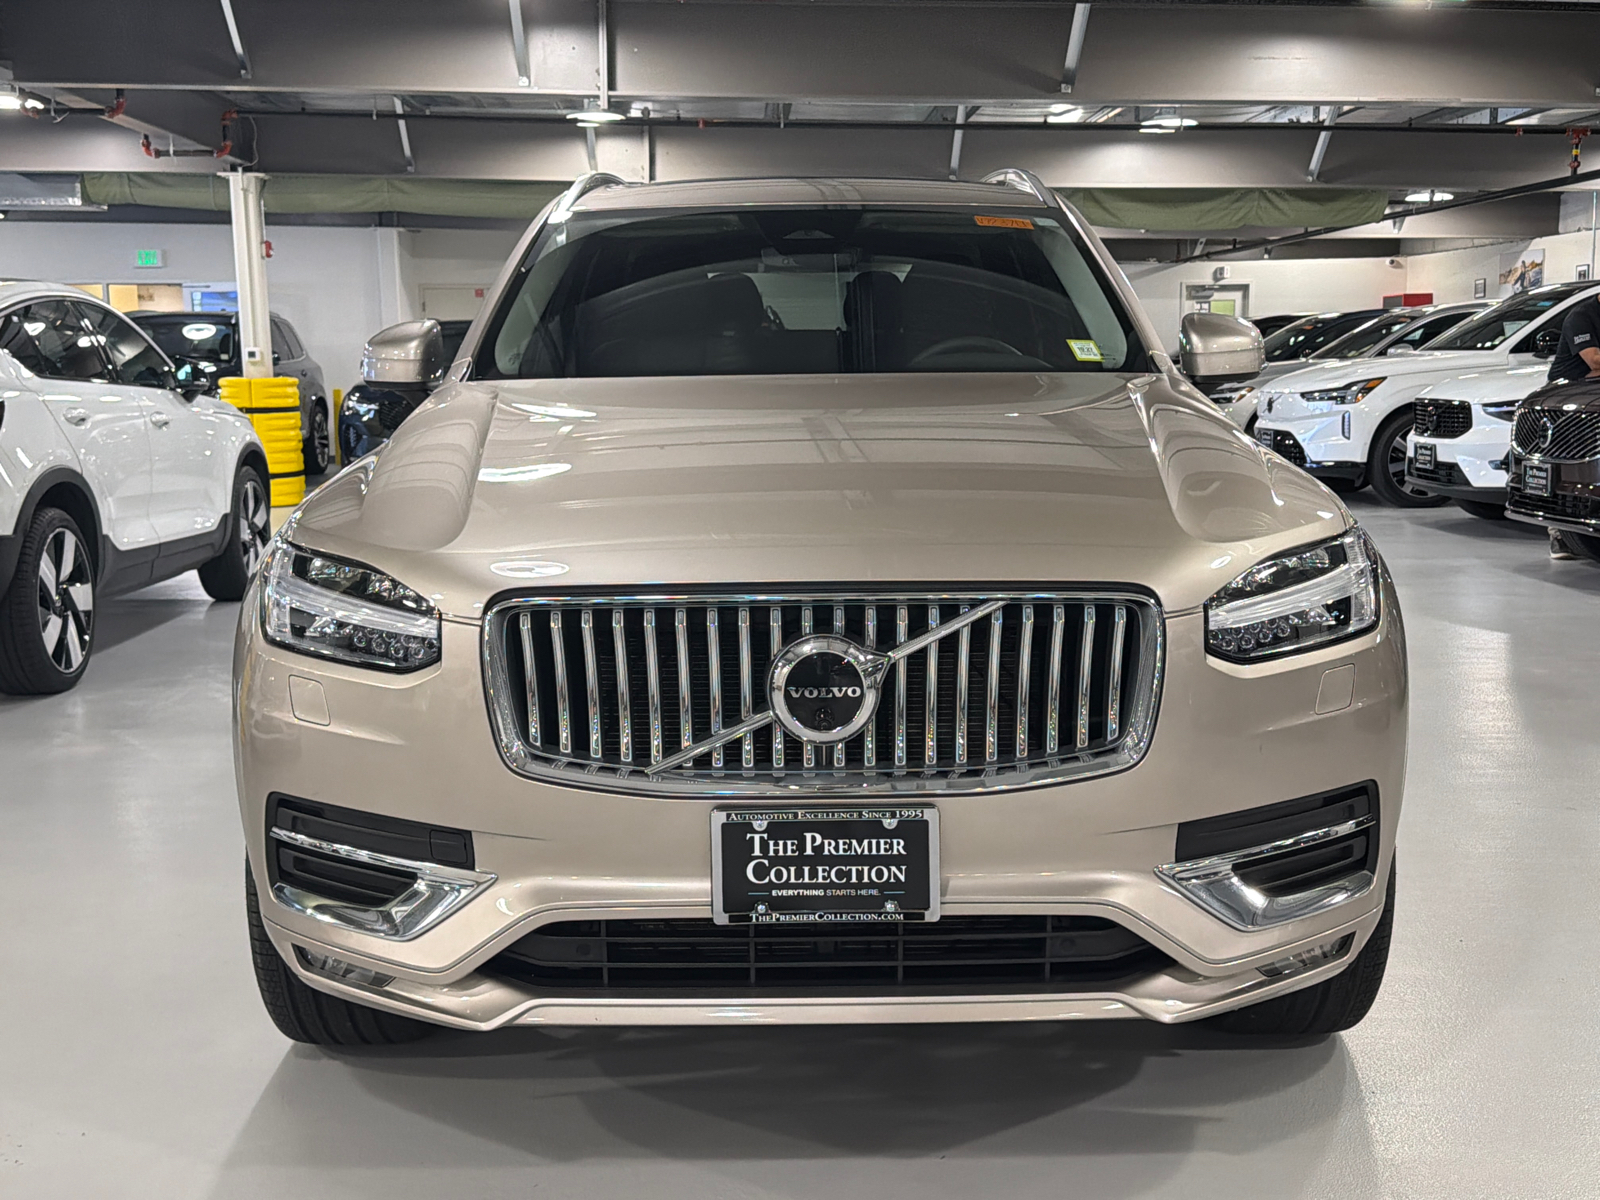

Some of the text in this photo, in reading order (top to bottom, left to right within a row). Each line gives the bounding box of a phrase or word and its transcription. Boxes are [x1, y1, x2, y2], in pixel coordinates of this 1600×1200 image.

[787, 686, 861, 698] VOLVO
[729, 810, 922, 821] AUTOMOTIVE EXCELLENCE SINCE 1995
[746, 832, 907, 856] THE PREMIER
[746, 859, 907, 884] COLLECTION
[857, 888, 881, 896] HERE.
[750, 912, 904, 922] THEPREMIERCOLLECTION.COM
